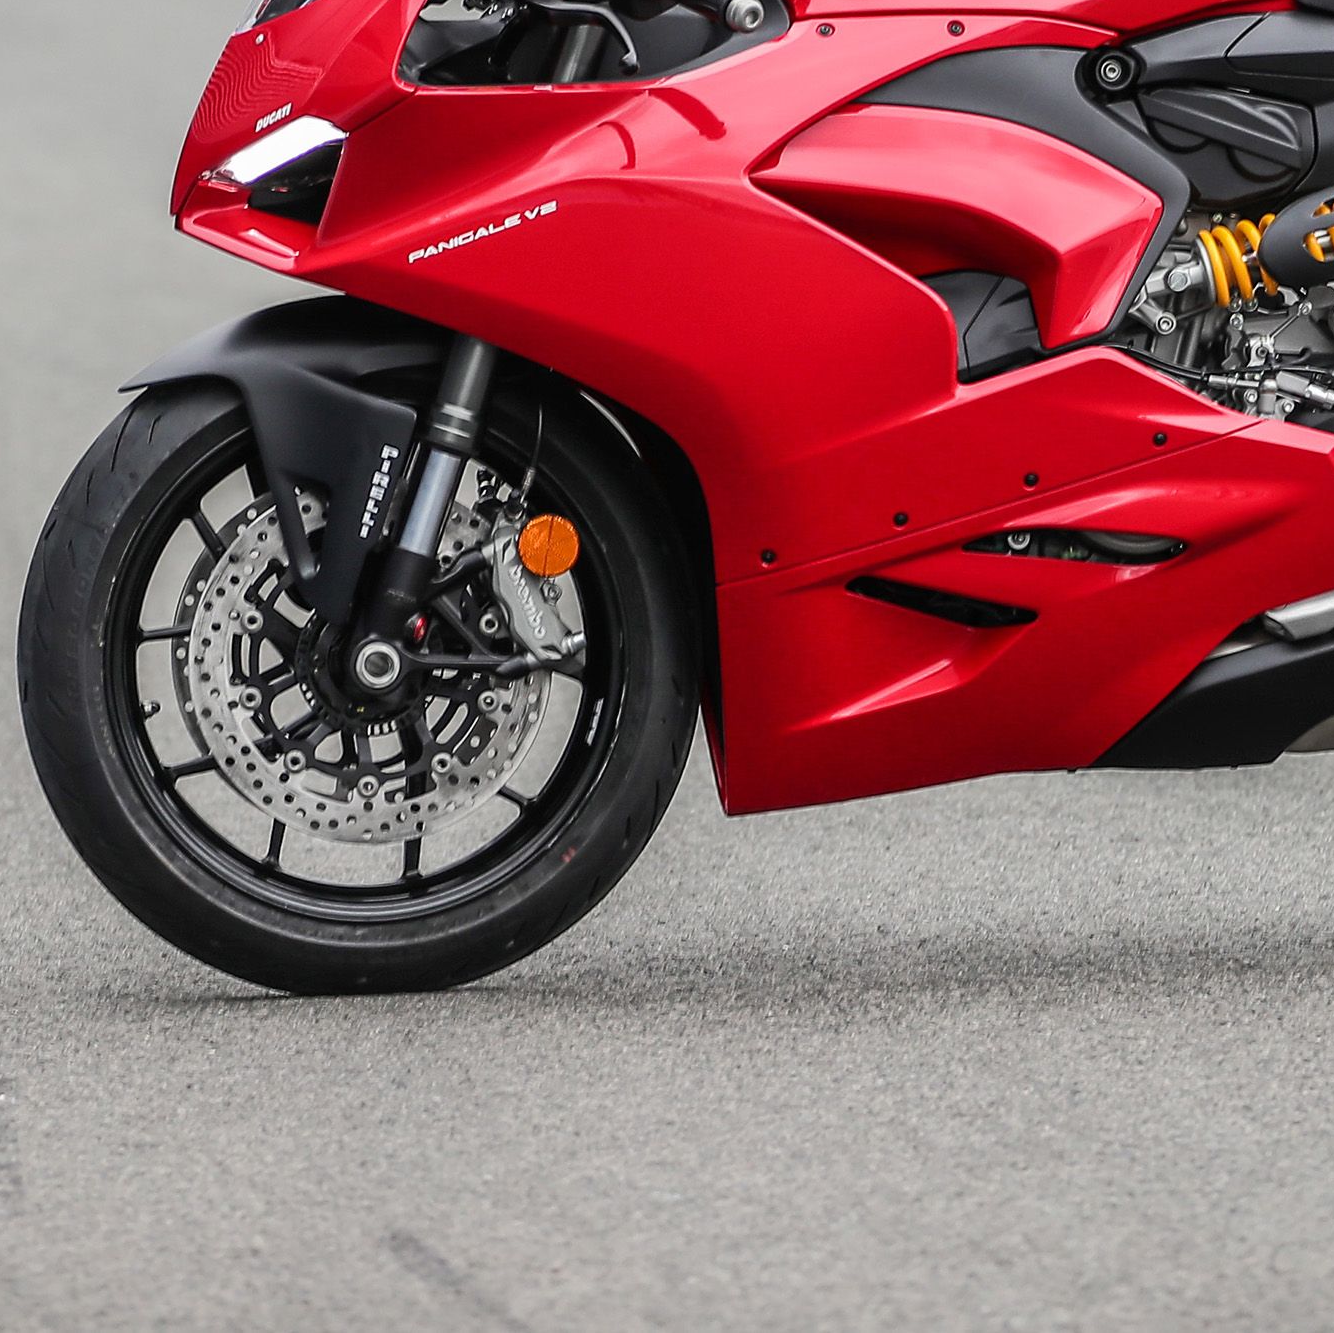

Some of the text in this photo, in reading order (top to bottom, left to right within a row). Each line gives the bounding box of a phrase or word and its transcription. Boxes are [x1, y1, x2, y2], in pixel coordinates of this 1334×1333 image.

[255, 102, 292, 133] DUCATI
[408, 200, 558, 264] PANIGALE V2
[359, 444, 400, 539] PIRELLI
[508, 564, 547, 640] brembo
